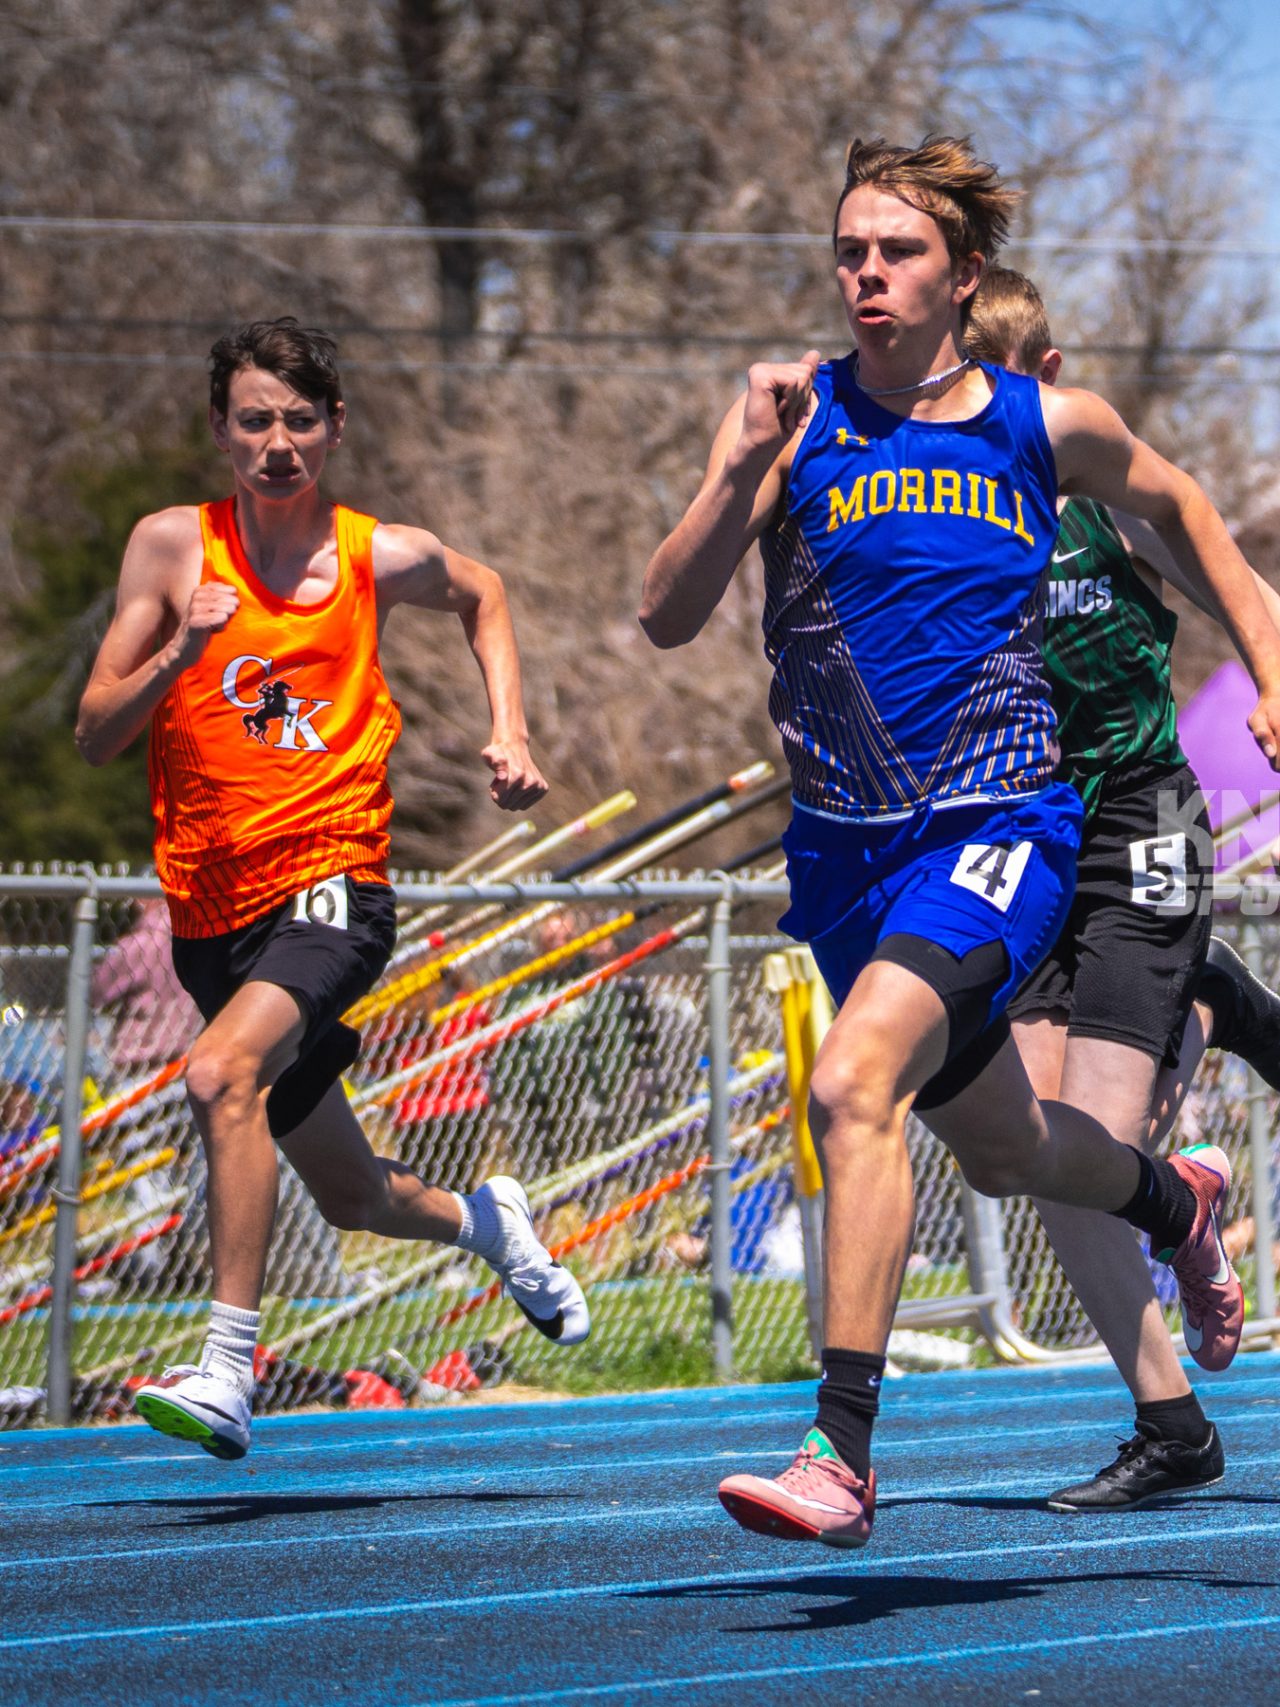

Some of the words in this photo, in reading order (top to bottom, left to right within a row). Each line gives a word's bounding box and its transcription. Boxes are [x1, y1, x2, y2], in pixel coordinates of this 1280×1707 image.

[826, 469, 1034, 546] MORRILL
[1044, 575, 1112, 618] INGS
[966, 845, 1010, 898] 4
[1144, 838, 1177, 902] 5
[305, 886, 337, 924] 6
